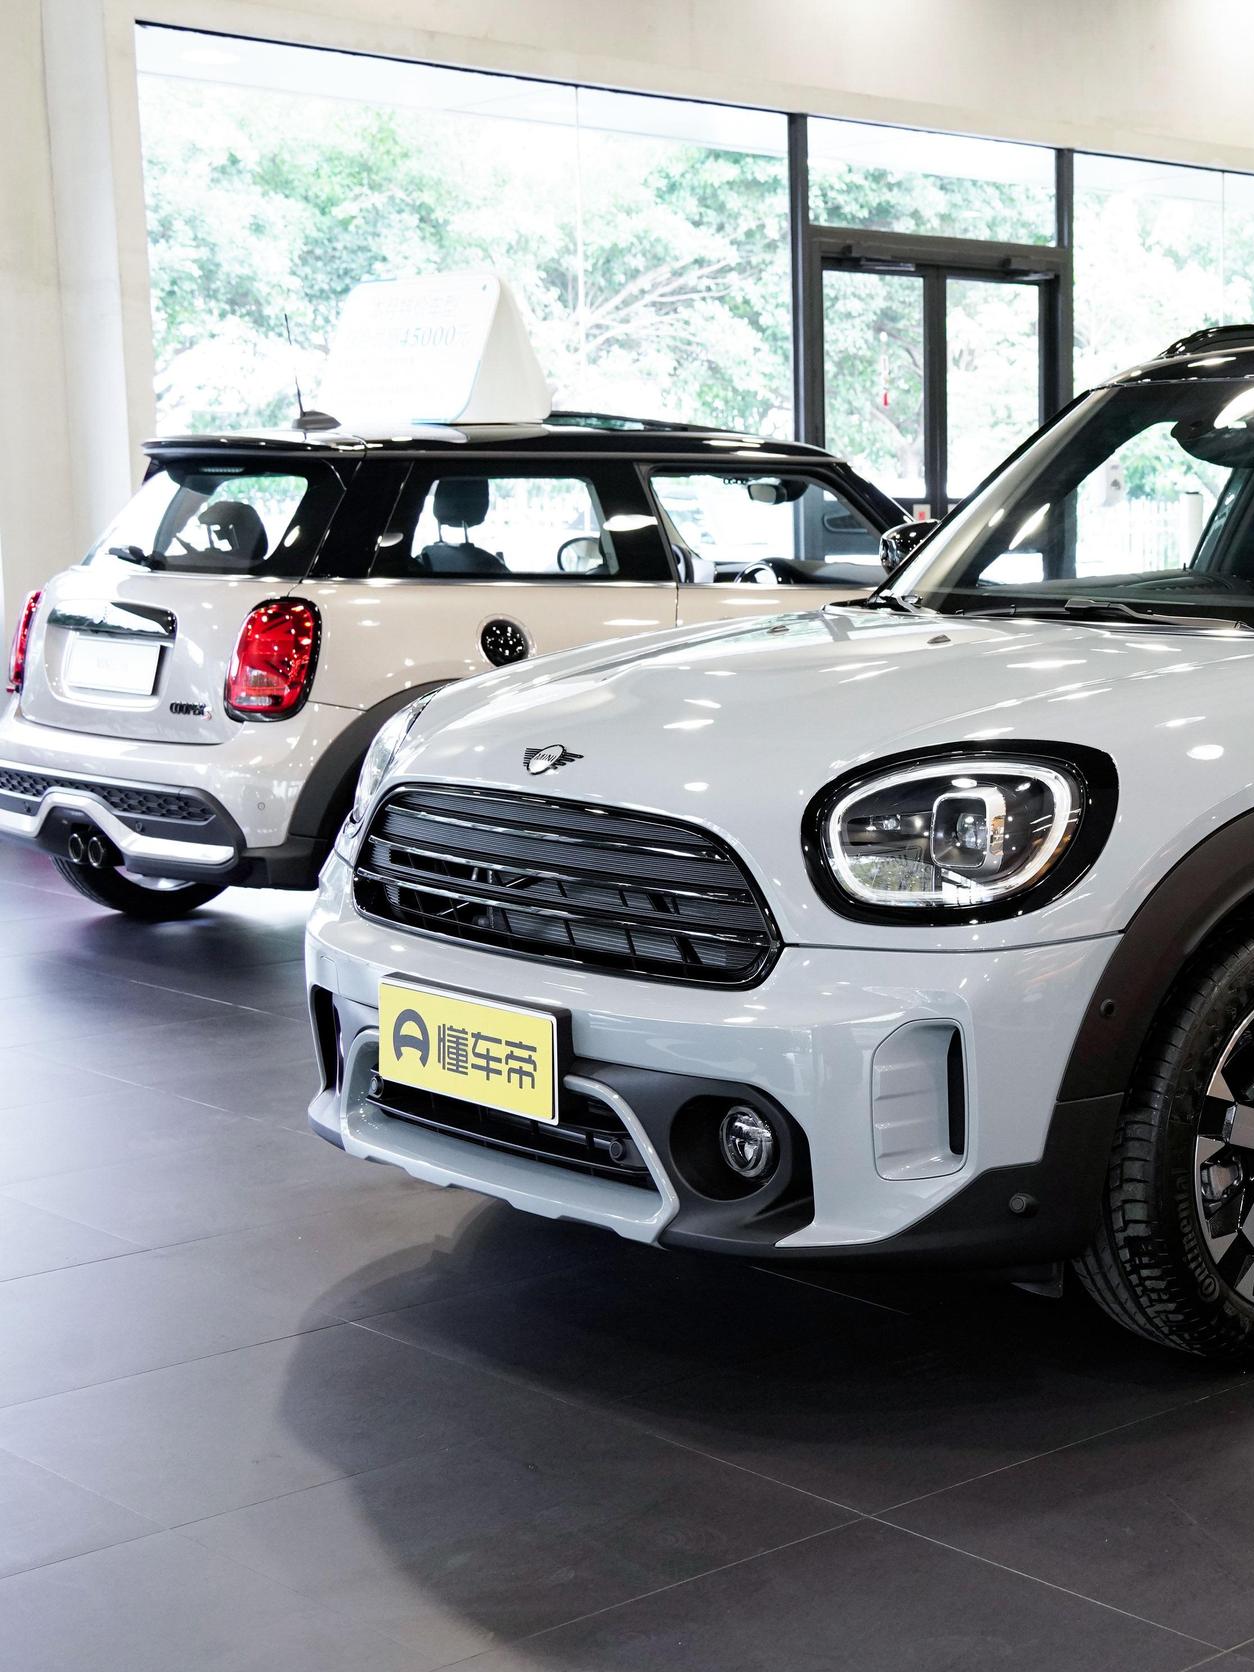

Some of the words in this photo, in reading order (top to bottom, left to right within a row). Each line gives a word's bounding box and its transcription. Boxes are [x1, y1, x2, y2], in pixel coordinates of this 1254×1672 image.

[533, 752, 558, 763] MINI
[437, 1023, 538, 1090] 懂车帝
